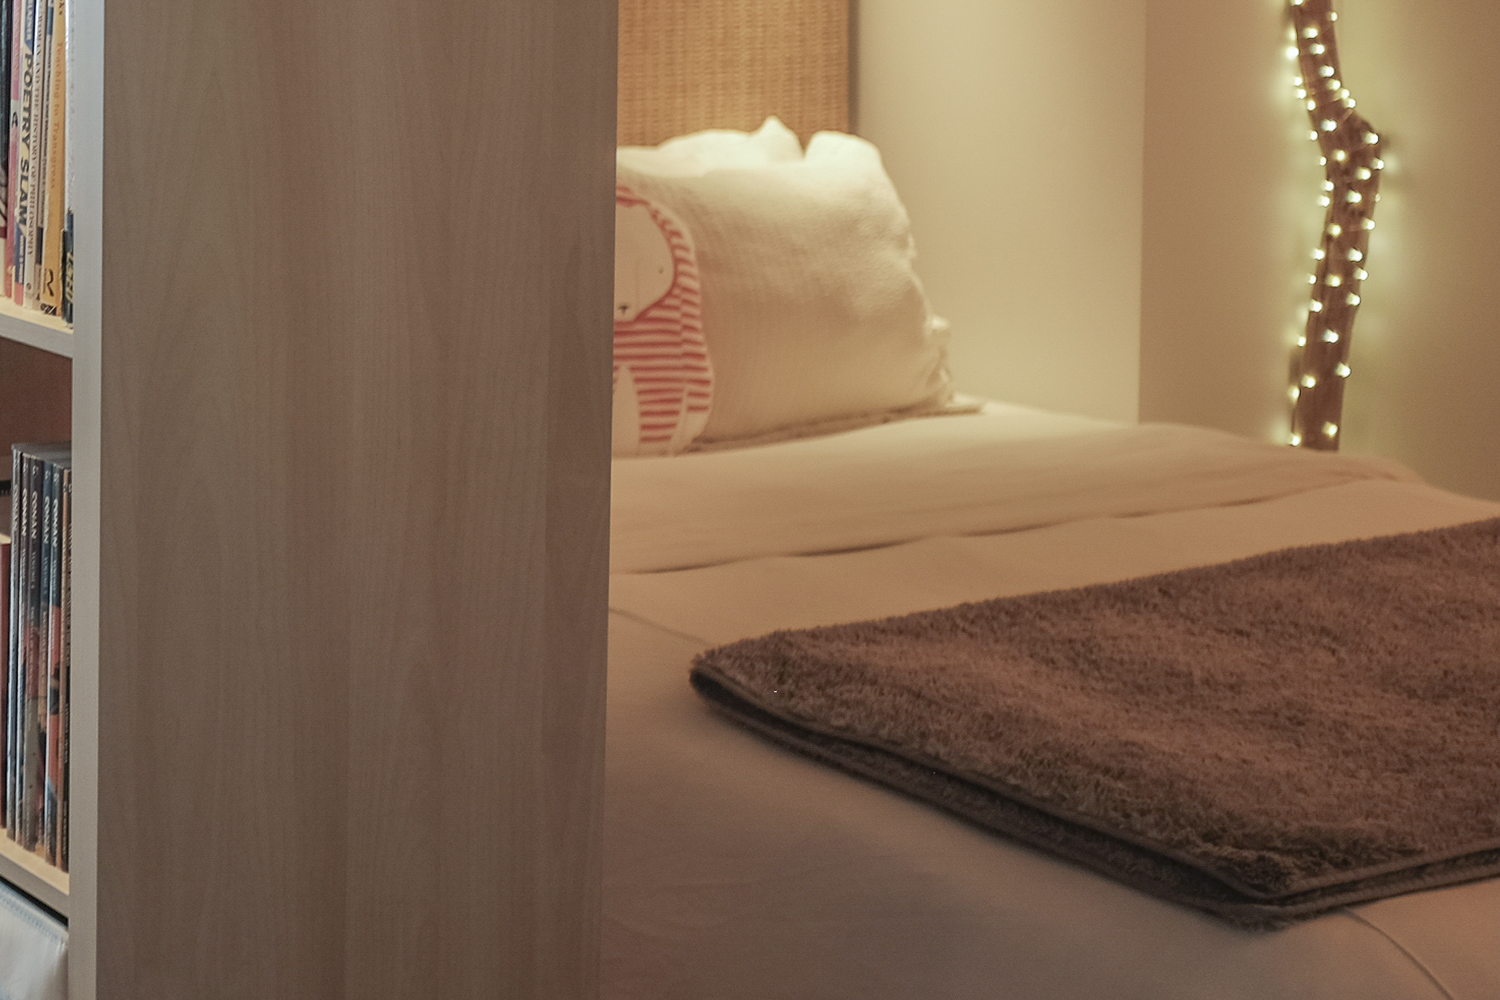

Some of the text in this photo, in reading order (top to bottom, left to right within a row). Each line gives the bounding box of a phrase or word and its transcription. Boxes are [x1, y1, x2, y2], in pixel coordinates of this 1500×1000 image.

[54, 42, 64, 99] Teaching
[21, 52, 33, 148] POETRY
[53, 103, 61, 116] to
[31, 113, 40, 162] HISTORY
[50, 122, 61, 190] Transgress
[18, 156, 29, 226] SLAM
[30, 165, 37, 181] OF
[27, 183, 37, 256] PHILOSOPHY
[21, 487, 29, 536] CONAN
[30, 490, 39, 540] CONAN
[43, 496, 51, 545] CONAN
[52, 498, 60, 547] CONAN
